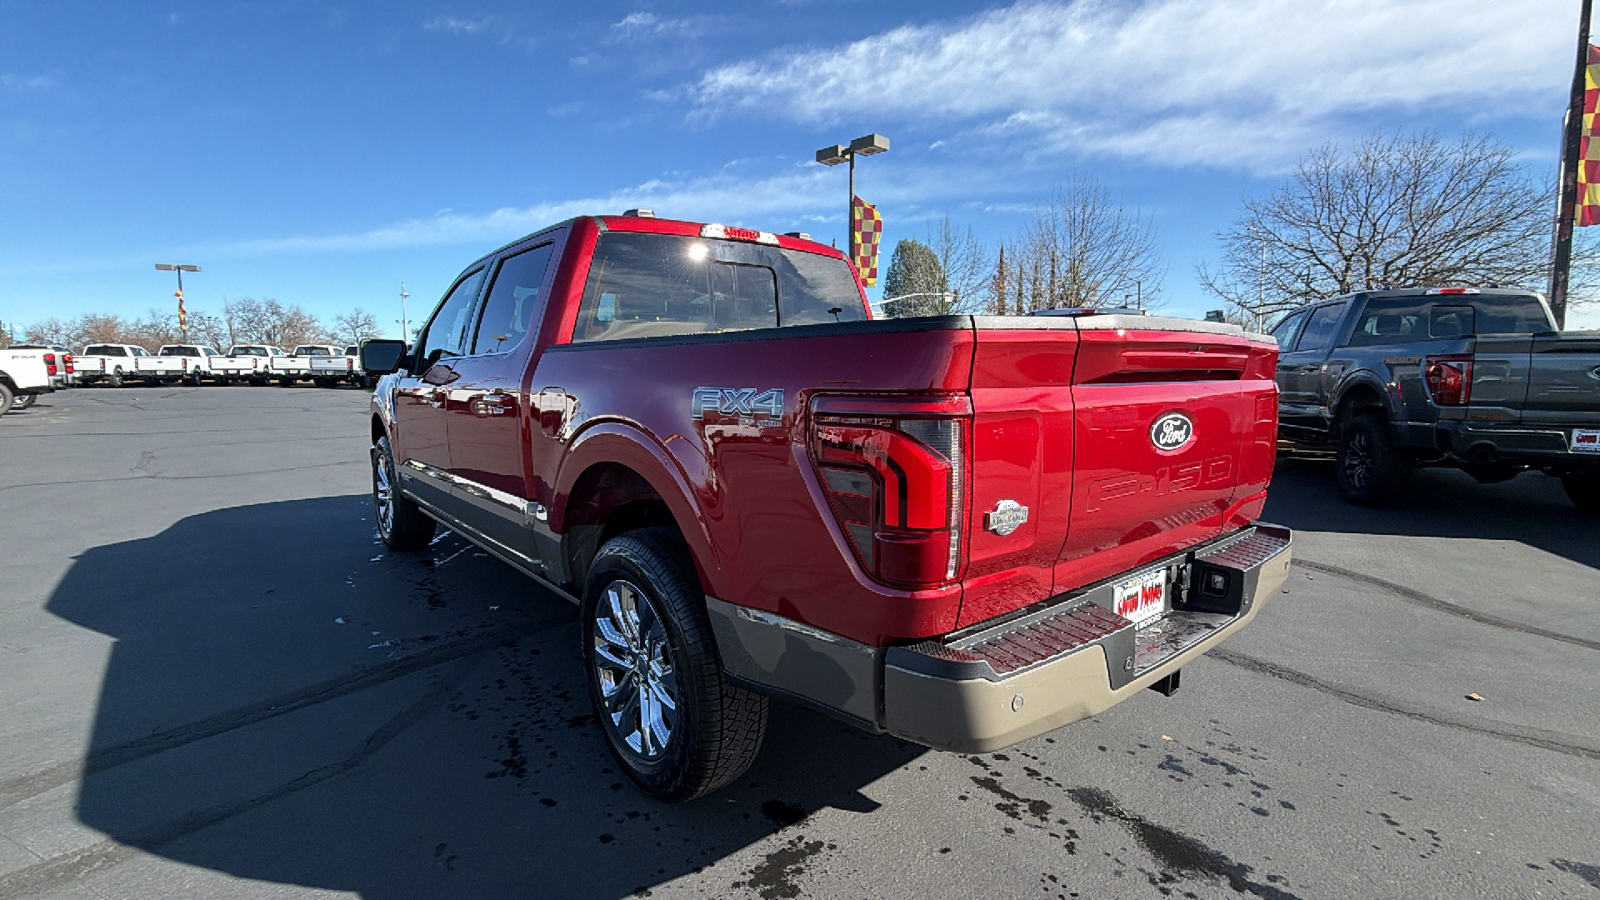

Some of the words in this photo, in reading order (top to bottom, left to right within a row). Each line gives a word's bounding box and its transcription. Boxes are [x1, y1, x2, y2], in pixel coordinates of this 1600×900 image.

[691, 387, 784, 420] FX4
[1158, 418, 1188, 445] Ford
[1087, 454, 1232, 513] F-150
